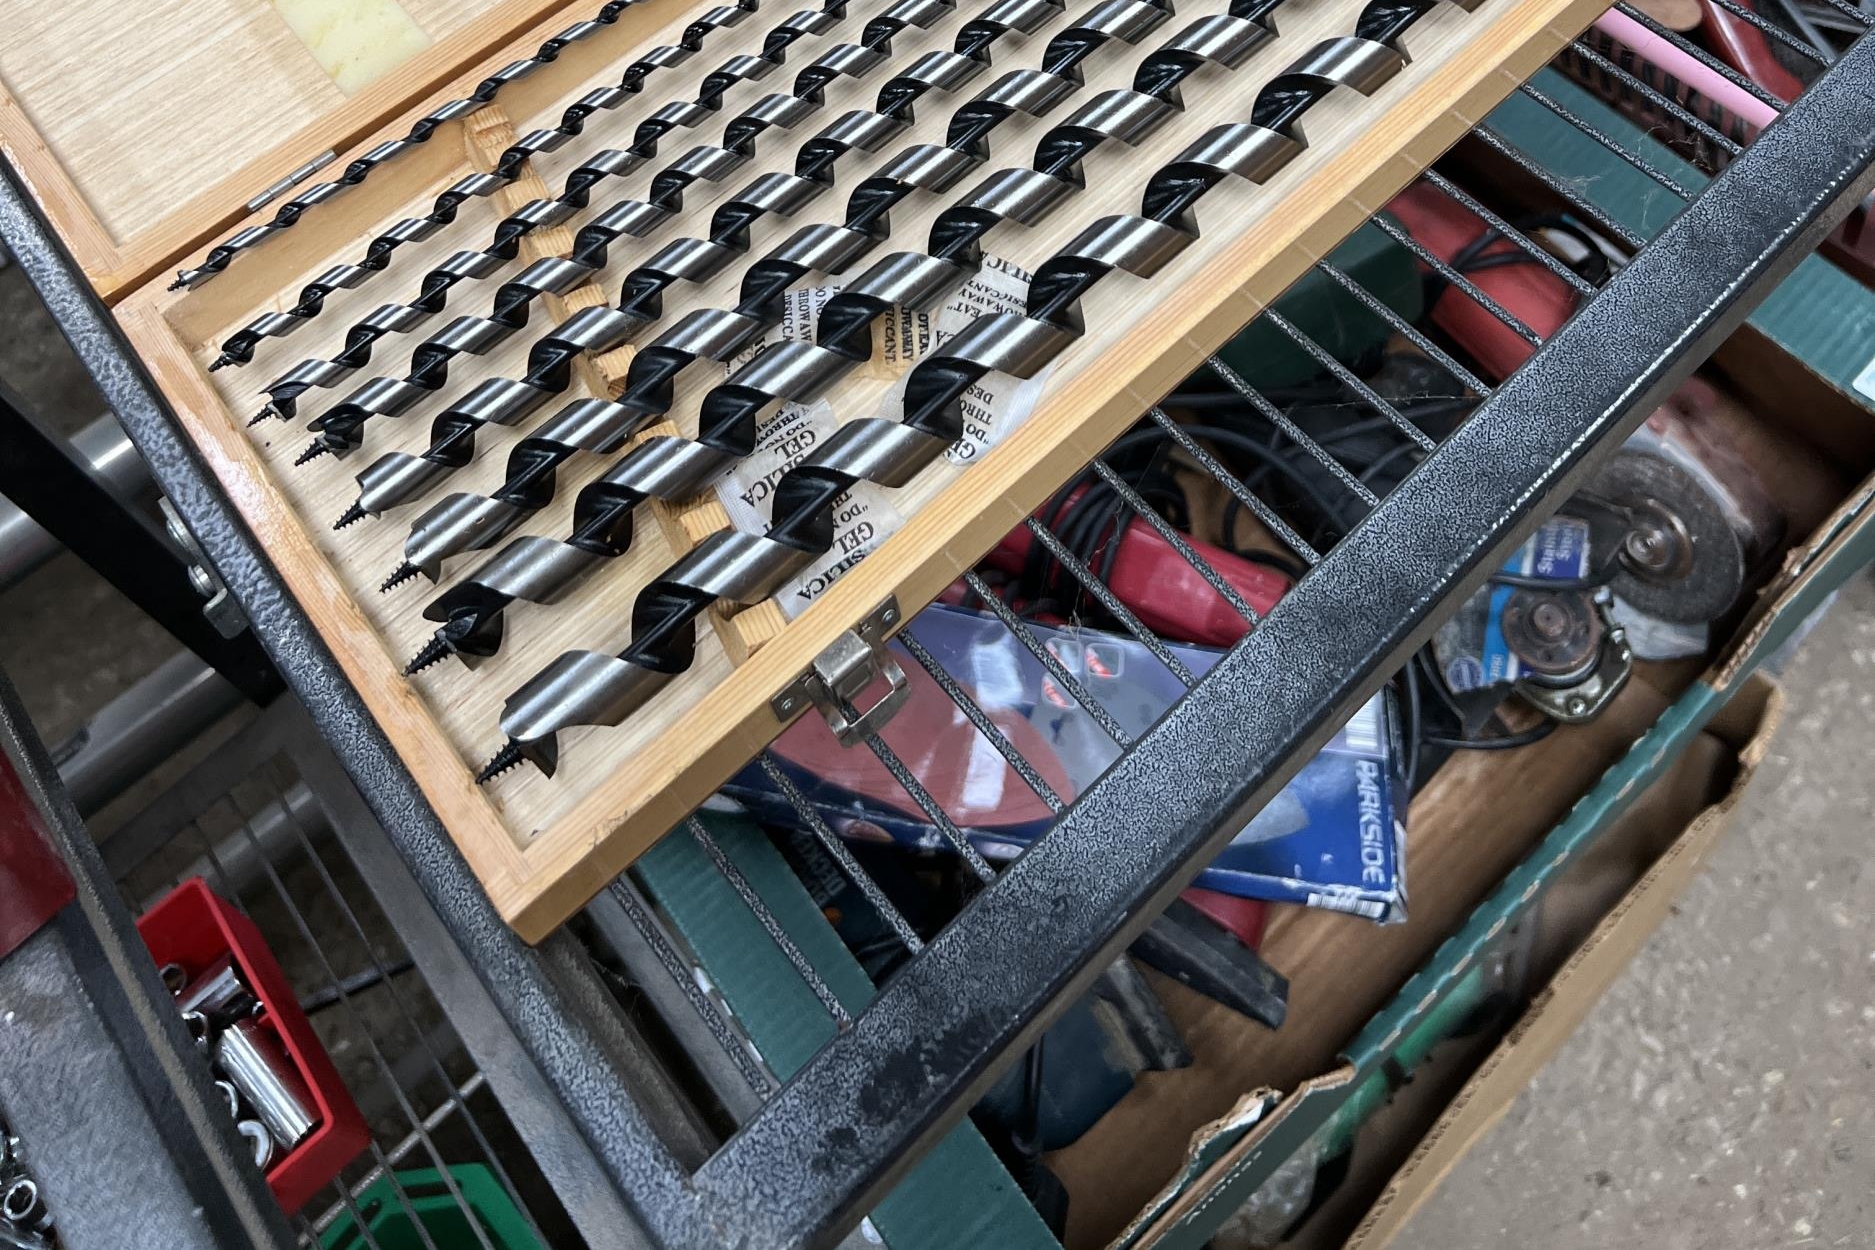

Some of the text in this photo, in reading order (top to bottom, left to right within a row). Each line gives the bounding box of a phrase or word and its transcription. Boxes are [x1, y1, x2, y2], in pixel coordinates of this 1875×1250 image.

[783, 294, 795, 342] DESICCA
[967, 280, 1027, 308] ESICCANT
[774, 429, 817, 459] GEL
[740, 453, 806, 508] SILICA
[832, 521, 874, 555] GEL
[797, 549, 867, 600] SILICA
[1355, 760, 1386, 885] PARKSIDE
